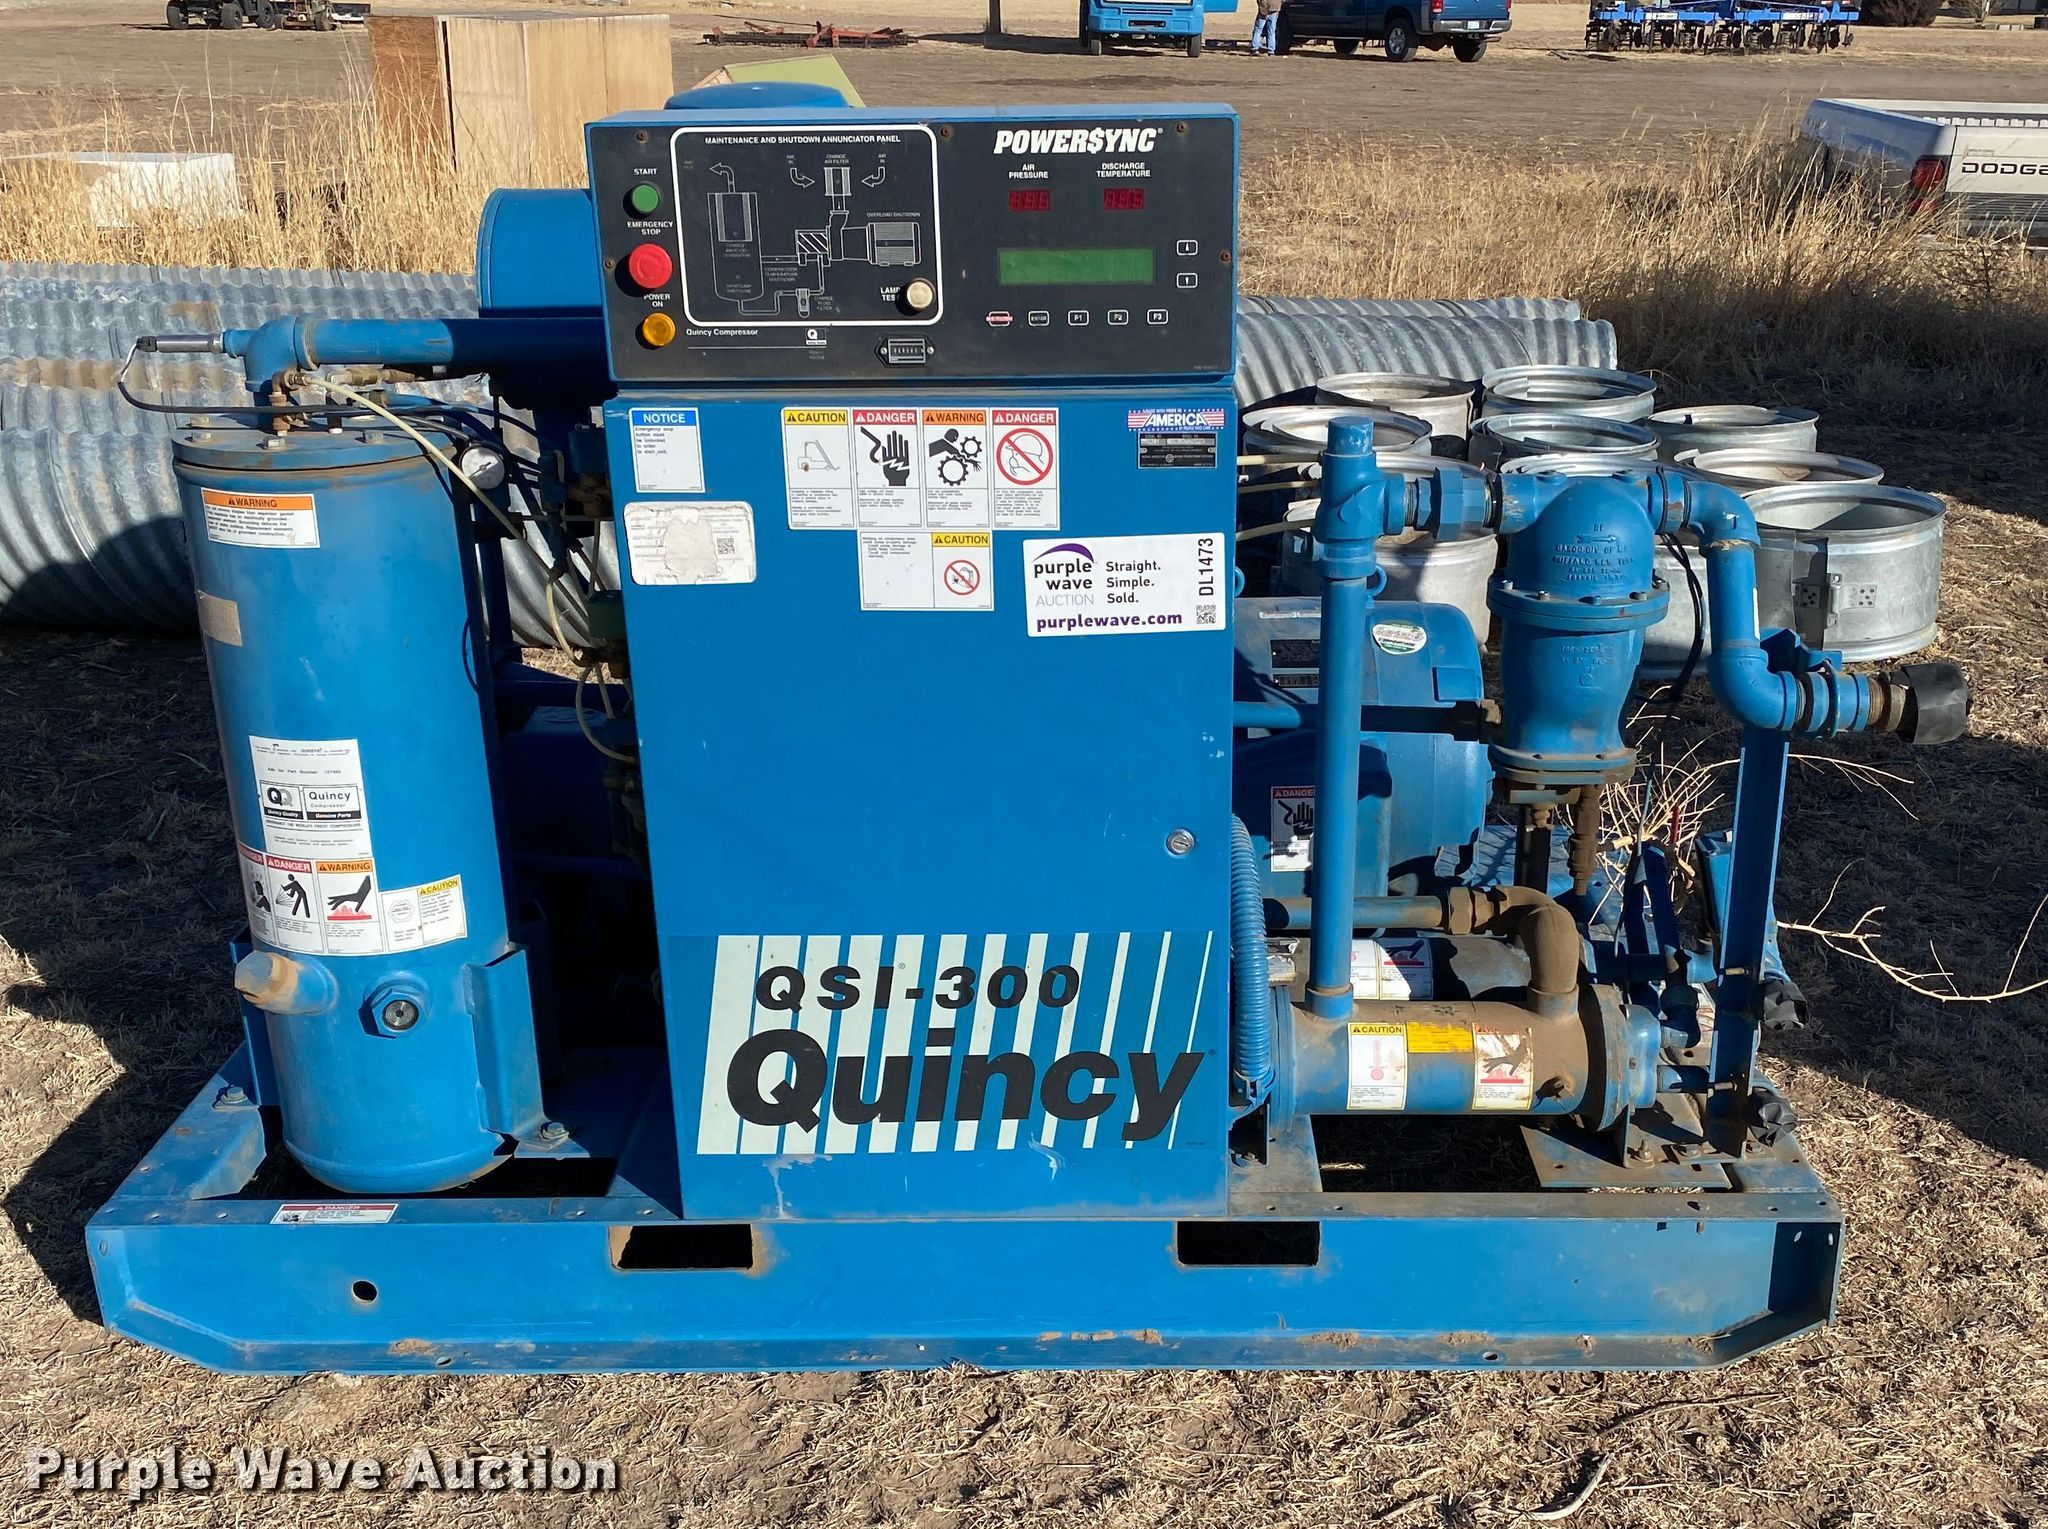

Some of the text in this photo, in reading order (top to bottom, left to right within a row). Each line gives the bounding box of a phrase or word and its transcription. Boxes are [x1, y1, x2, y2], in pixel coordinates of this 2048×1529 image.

[822, 135, 874, 143] ANNUNCIATOR
[1101, 162, 1145, 170] DISCHARGE
[1009, 171, 1049, 179] PRESSURE
[1096, 170, 1150, 178] TEMPERATURE
[627, 221, 673, 229] EMERGENCY
[641, 228, 661, 236] STOP
[881, 286, 900, 294] LAMP
[1074, 313, 1083, 321] F1
[1114, 312, 1122, 321] F2
[1153, 312, 1162, 321] F3
[686, 328, 758, 338] Quincy Compressor
[643, 413, 686, 424] NOTICE
[798, 412, 846, 423] CAUTION
[868, 413, 915, 423] DANGER
[936, 412, 984, 423] WARNING
[1005, 413, 1054, 423] DANGER
[1146, 413, 1208, 427] AMERICA
[235, 498, 278, 508] WARNING
[944, 535, 988, 544] CAUTION
[1034, 559, 1092, 577] purple
[1106, 560, 1161, 574] Straight.
[1198, 538, 1213, 596] DL1473
[1046, 578, 1093, 590] wave
[1106, 576, 1155, 590] Simple.
[1036, 594, 1094, 606] AUCTION
[1107, 593, 1139, 604] Sold.
[1037, 613, 1182, 632] purplewave.com
[309, 791, 351, 801] Quincy
[274, 861, 310, 871] DANGER
[327, 862, 371, 872] WARNING
[427, 880, 458, 895] CAUTION
[755, 965, 1080, 1013] QSI-300
[1361, 1025, 1402, 1034] CAUTION
[727, 1028, 1205, 1141] Quincy
